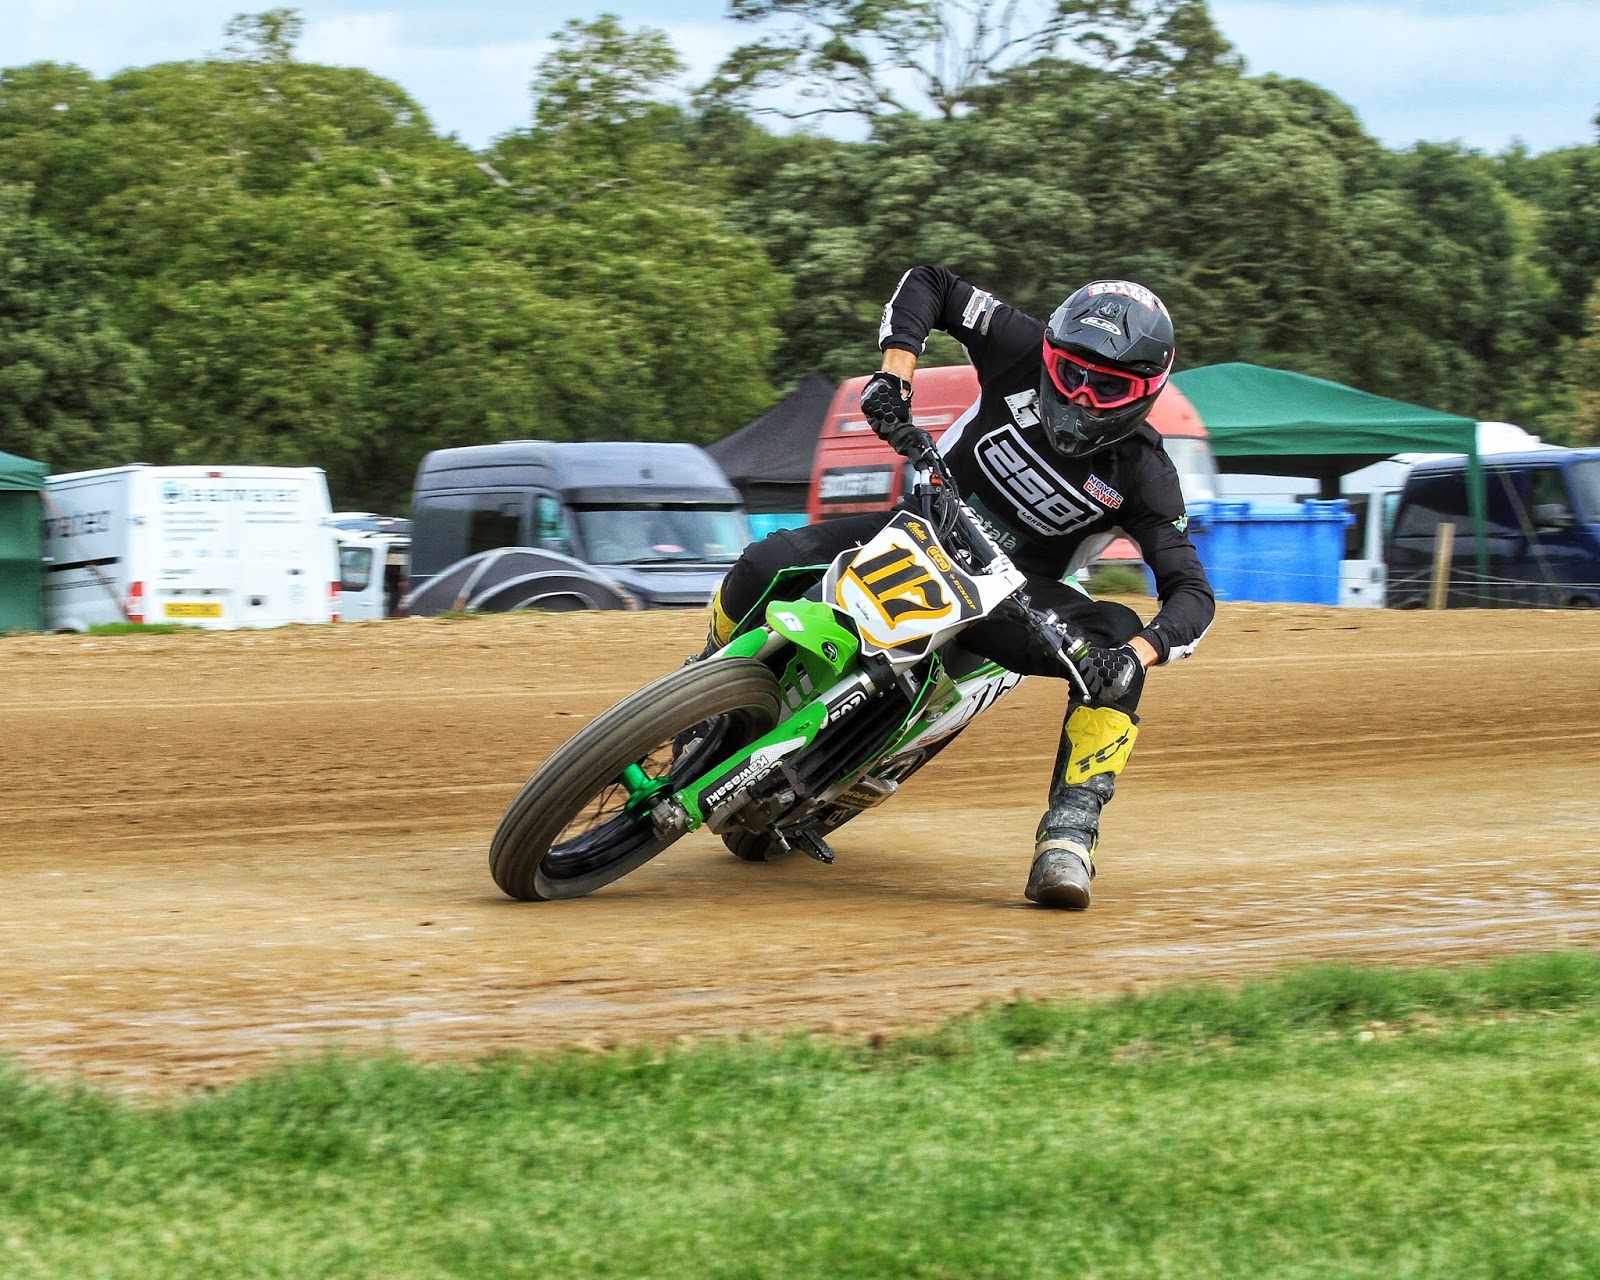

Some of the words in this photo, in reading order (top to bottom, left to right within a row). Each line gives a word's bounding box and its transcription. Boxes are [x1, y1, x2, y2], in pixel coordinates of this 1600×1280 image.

[1085, 481, 1120, 508] CAMP
[1089, 475, 1123, 502] NOYES
[1021, 511, 1053, 533] LONDON
[847, 543, 953, 630] 117
[953, 579, 977, 610] DUNLOP
[705, 755, 769, 807] Kawasaki
